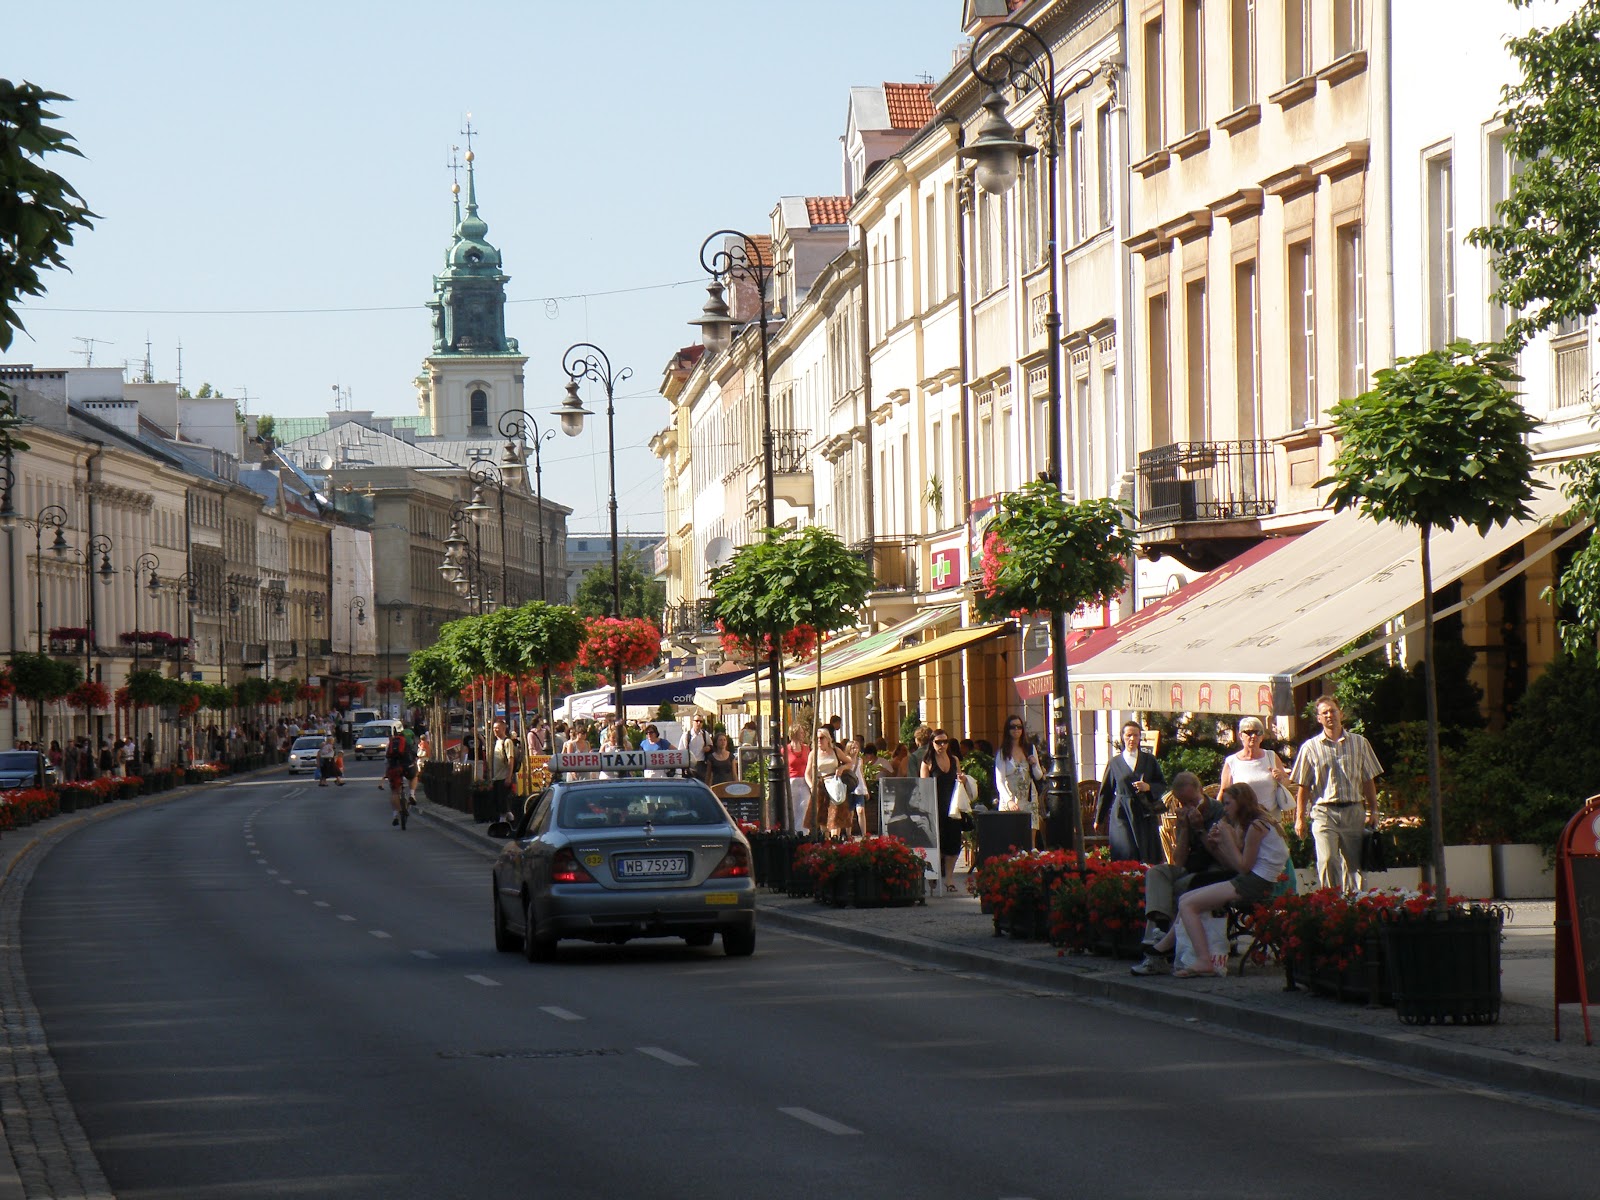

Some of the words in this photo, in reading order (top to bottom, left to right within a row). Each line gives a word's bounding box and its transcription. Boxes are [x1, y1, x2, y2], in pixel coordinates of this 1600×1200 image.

[562, 752, 599, 767] SUPER
[603, 753, 643, 767] TAXI
[626, 860, 643, 873] WB
[647, 859, 684, 872] 75937
